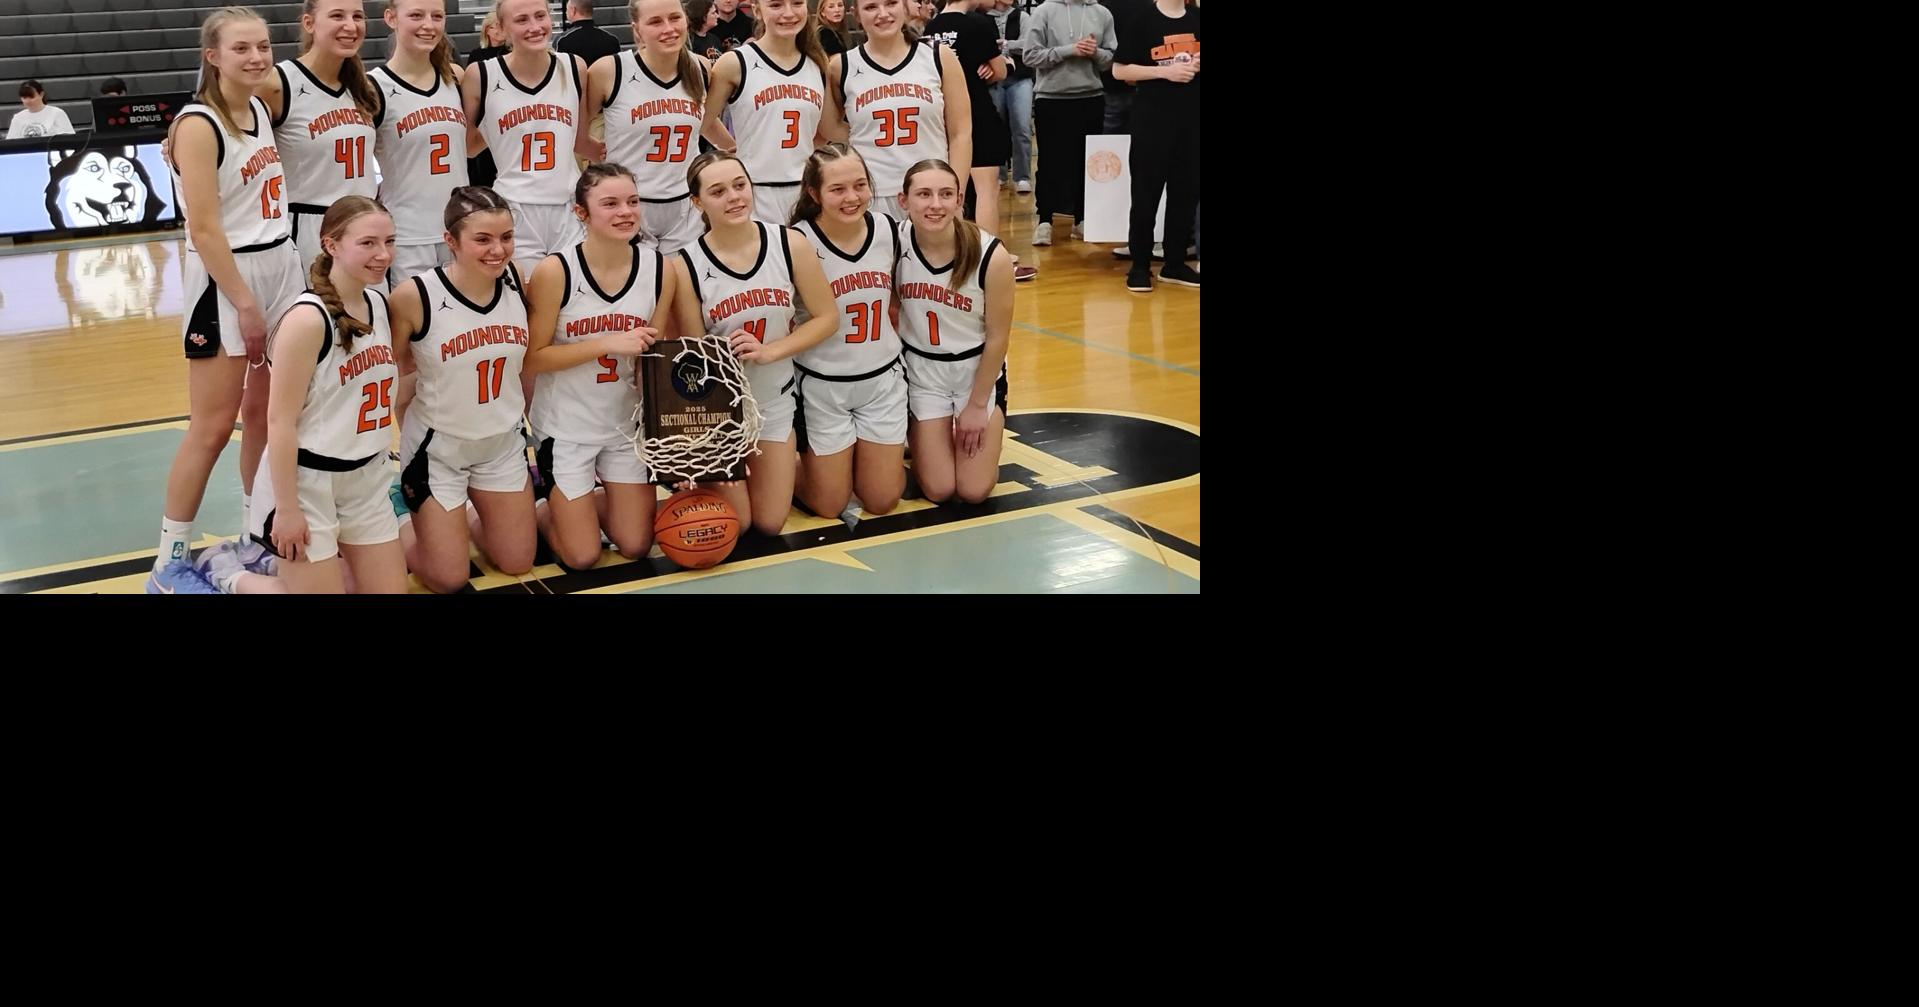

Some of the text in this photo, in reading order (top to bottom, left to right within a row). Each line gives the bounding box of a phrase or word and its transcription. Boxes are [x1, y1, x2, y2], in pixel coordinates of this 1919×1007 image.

[132, 104, 157, 113] POSS
[754, 84, 824, 111] MOUNDERS
[855, 83, 933, 113] MOUNDERS
[129, 114, 162, 124] BONUS
[308, 108, 375, 140] MOUNDE
[396, 105, 467, 140] MOUNDERS
[498, 104, 573, 136] MOUNDERS
[781, 110, 800, 149] 3
[872, 106, 920, 147] 35
[334, 135, 365, 180] 41
[430, 133, 450, 176] 2
[521, 131, 556, 172] 13
[646, 125, 693, 162] 33
[260, 174, 283, 220] 15
[709, 288, 790, 323] MOUNDERS
[845, 299, 882, 344] 31
[440, 324, 530, 362] MOUNDERS
[926, 310, 940, 346] 1
[338, 344, 395, 386] MOUNDE
[476, 356, 507, 405] 11
[356, 377, 394, 434] 25
[660, 413, 697, 427] SECTIONAL
[671, 502, 728, 521] SPALDING
[678, 523, 728, 539] LEGACY
